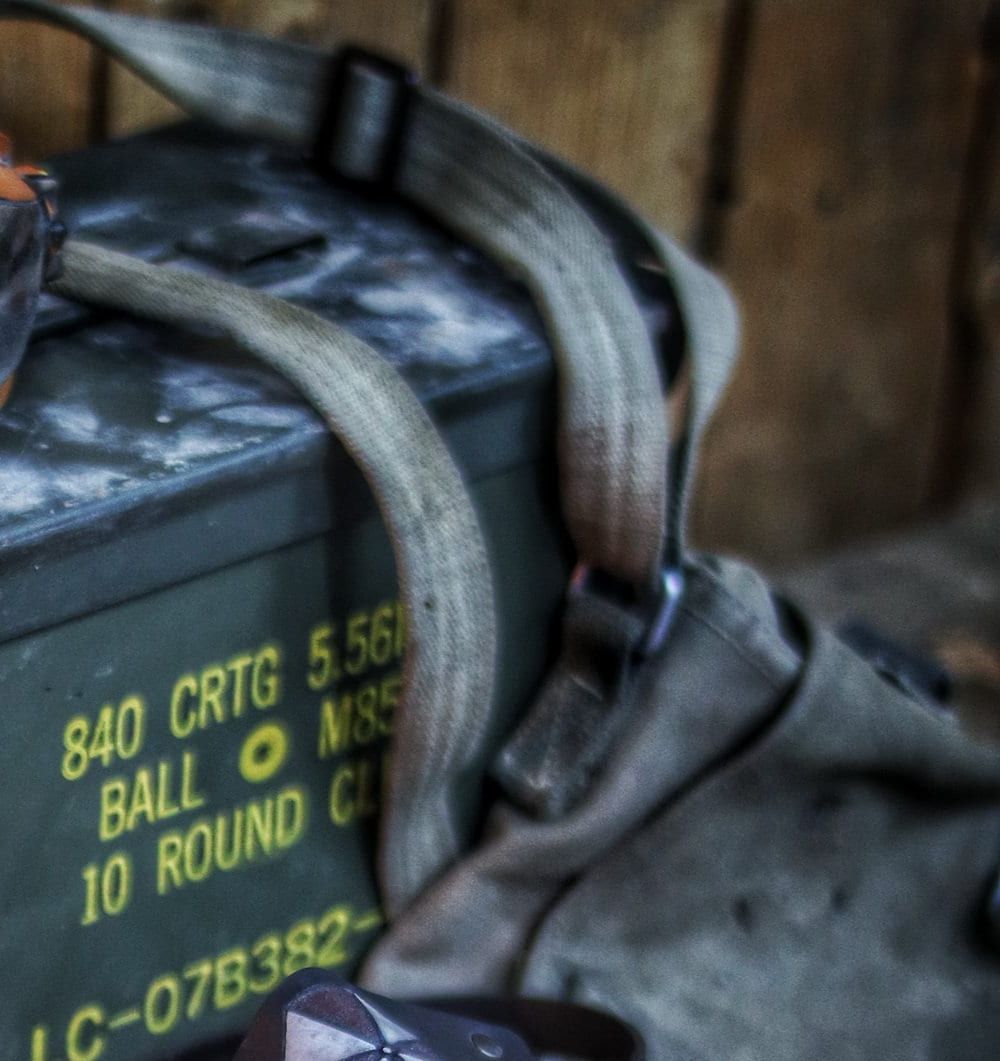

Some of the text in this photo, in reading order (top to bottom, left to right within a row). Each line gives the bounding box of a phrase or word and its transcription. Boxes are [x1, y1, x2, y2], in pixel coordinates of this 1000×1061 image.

[62, 696, 143, 781] 840
[170, 645, 280, 739] CRTG
[81, 853, 130, 926] 10
[157, 787, 304, 895] ROUND
[99, 752, 205, 841] BALL
